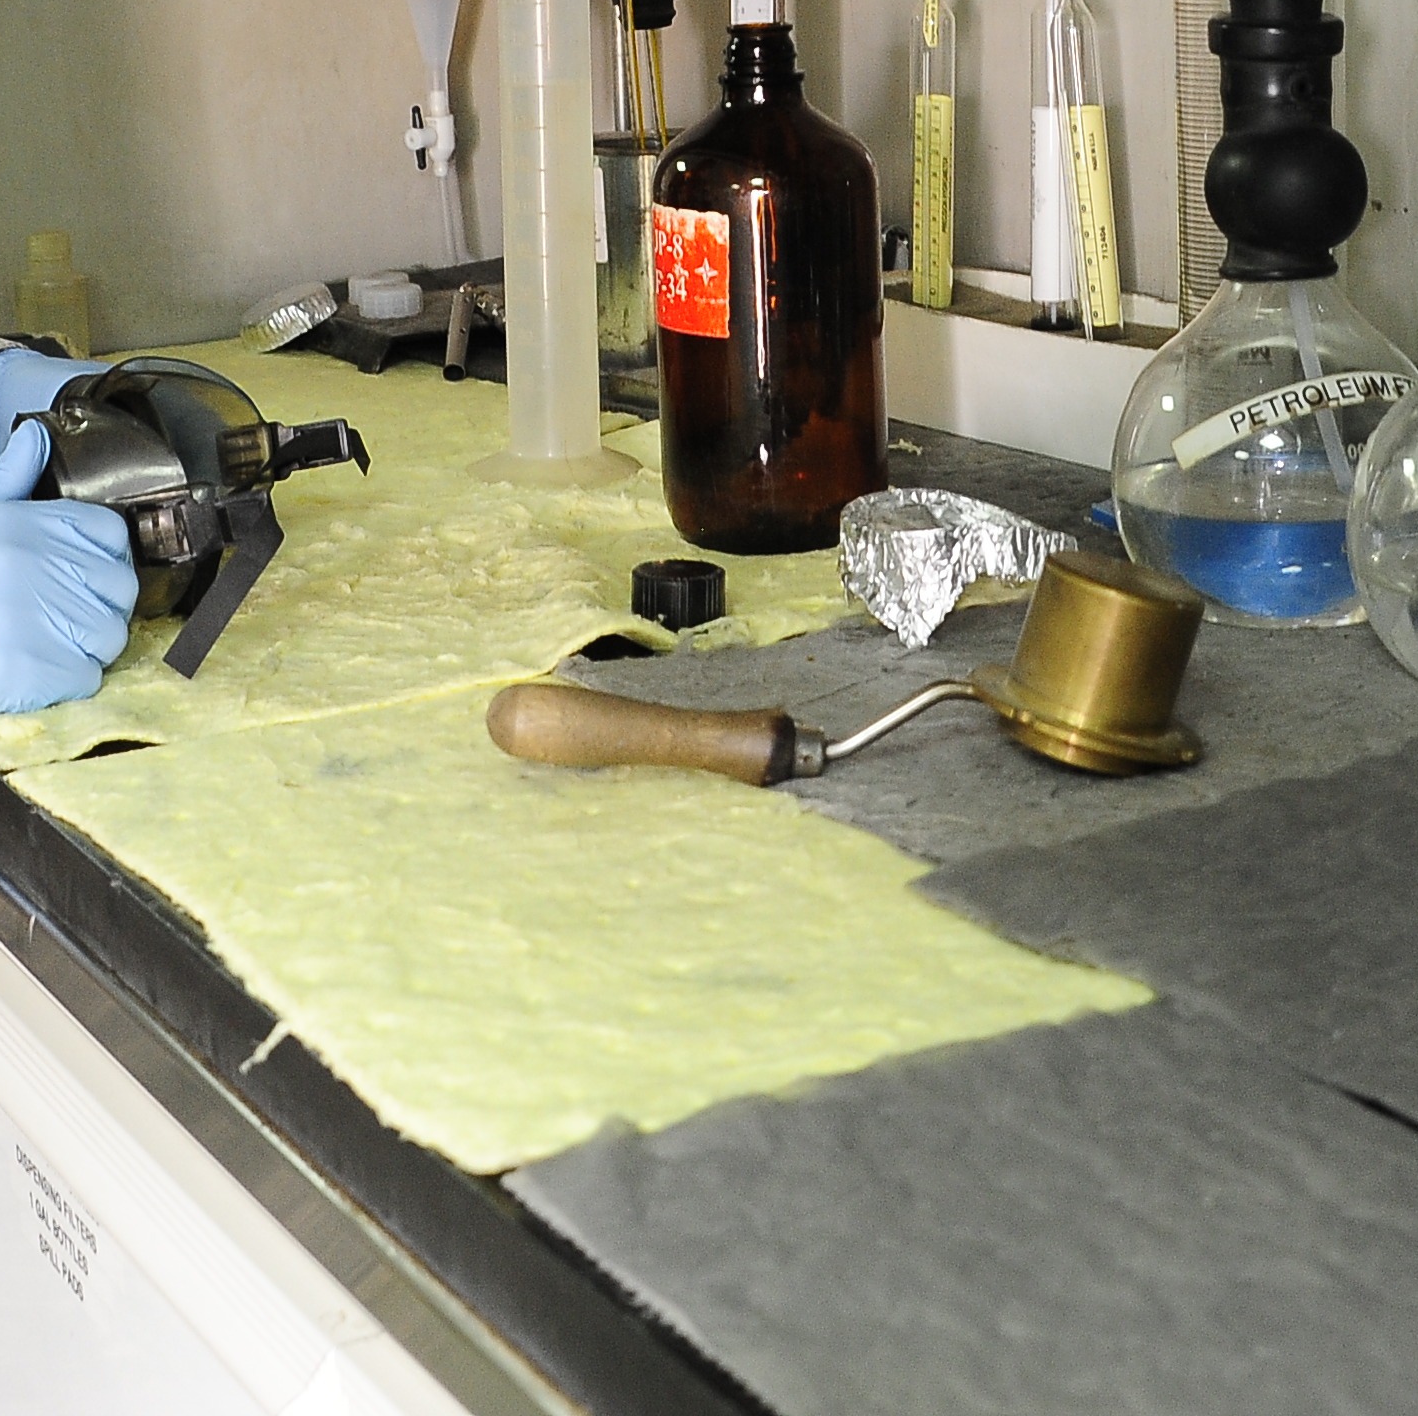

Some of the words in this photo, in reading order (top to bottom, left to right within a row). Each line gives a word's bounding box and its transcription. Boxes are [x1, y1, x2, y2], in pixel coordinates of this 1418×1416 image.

[1230, 376, 1391, 433] PETROLEUM
[52, 1219, 89, 1276] BOTTLES
[63, 1200, 98, 1254] FILTERS
